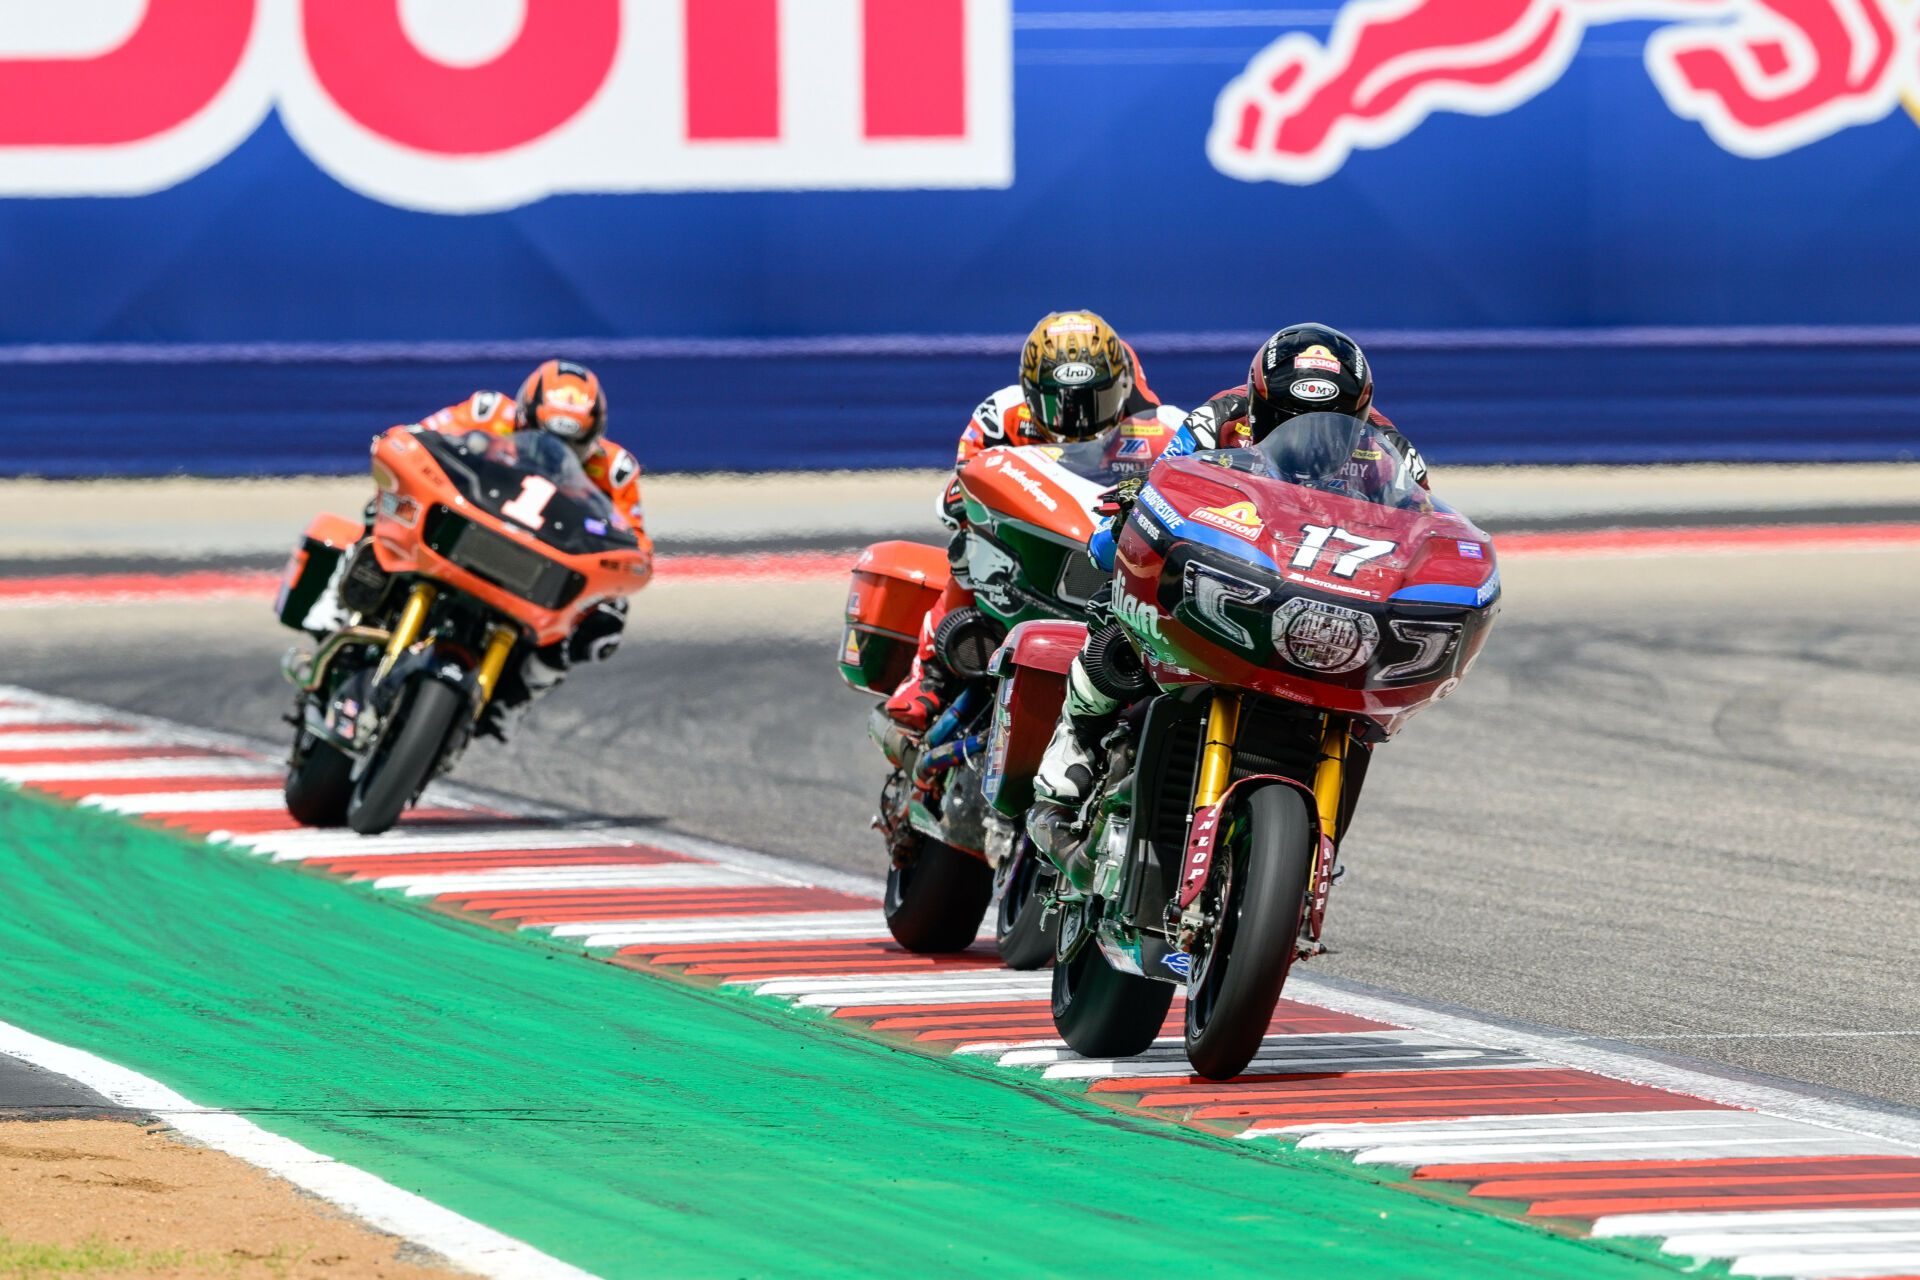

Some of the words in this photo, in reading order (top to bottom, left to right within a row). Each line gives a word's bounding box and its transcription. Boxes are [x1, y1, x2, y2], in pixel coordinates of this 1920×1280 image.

[1056, 364, 1089, 378] Arai
[501, 475, 557, 531] 1
[1139, 484, 1185, 530] PROGRESSIVE
[1194, 509, 1259, 538] mission
[1286, 523, 1400, 580] 17
